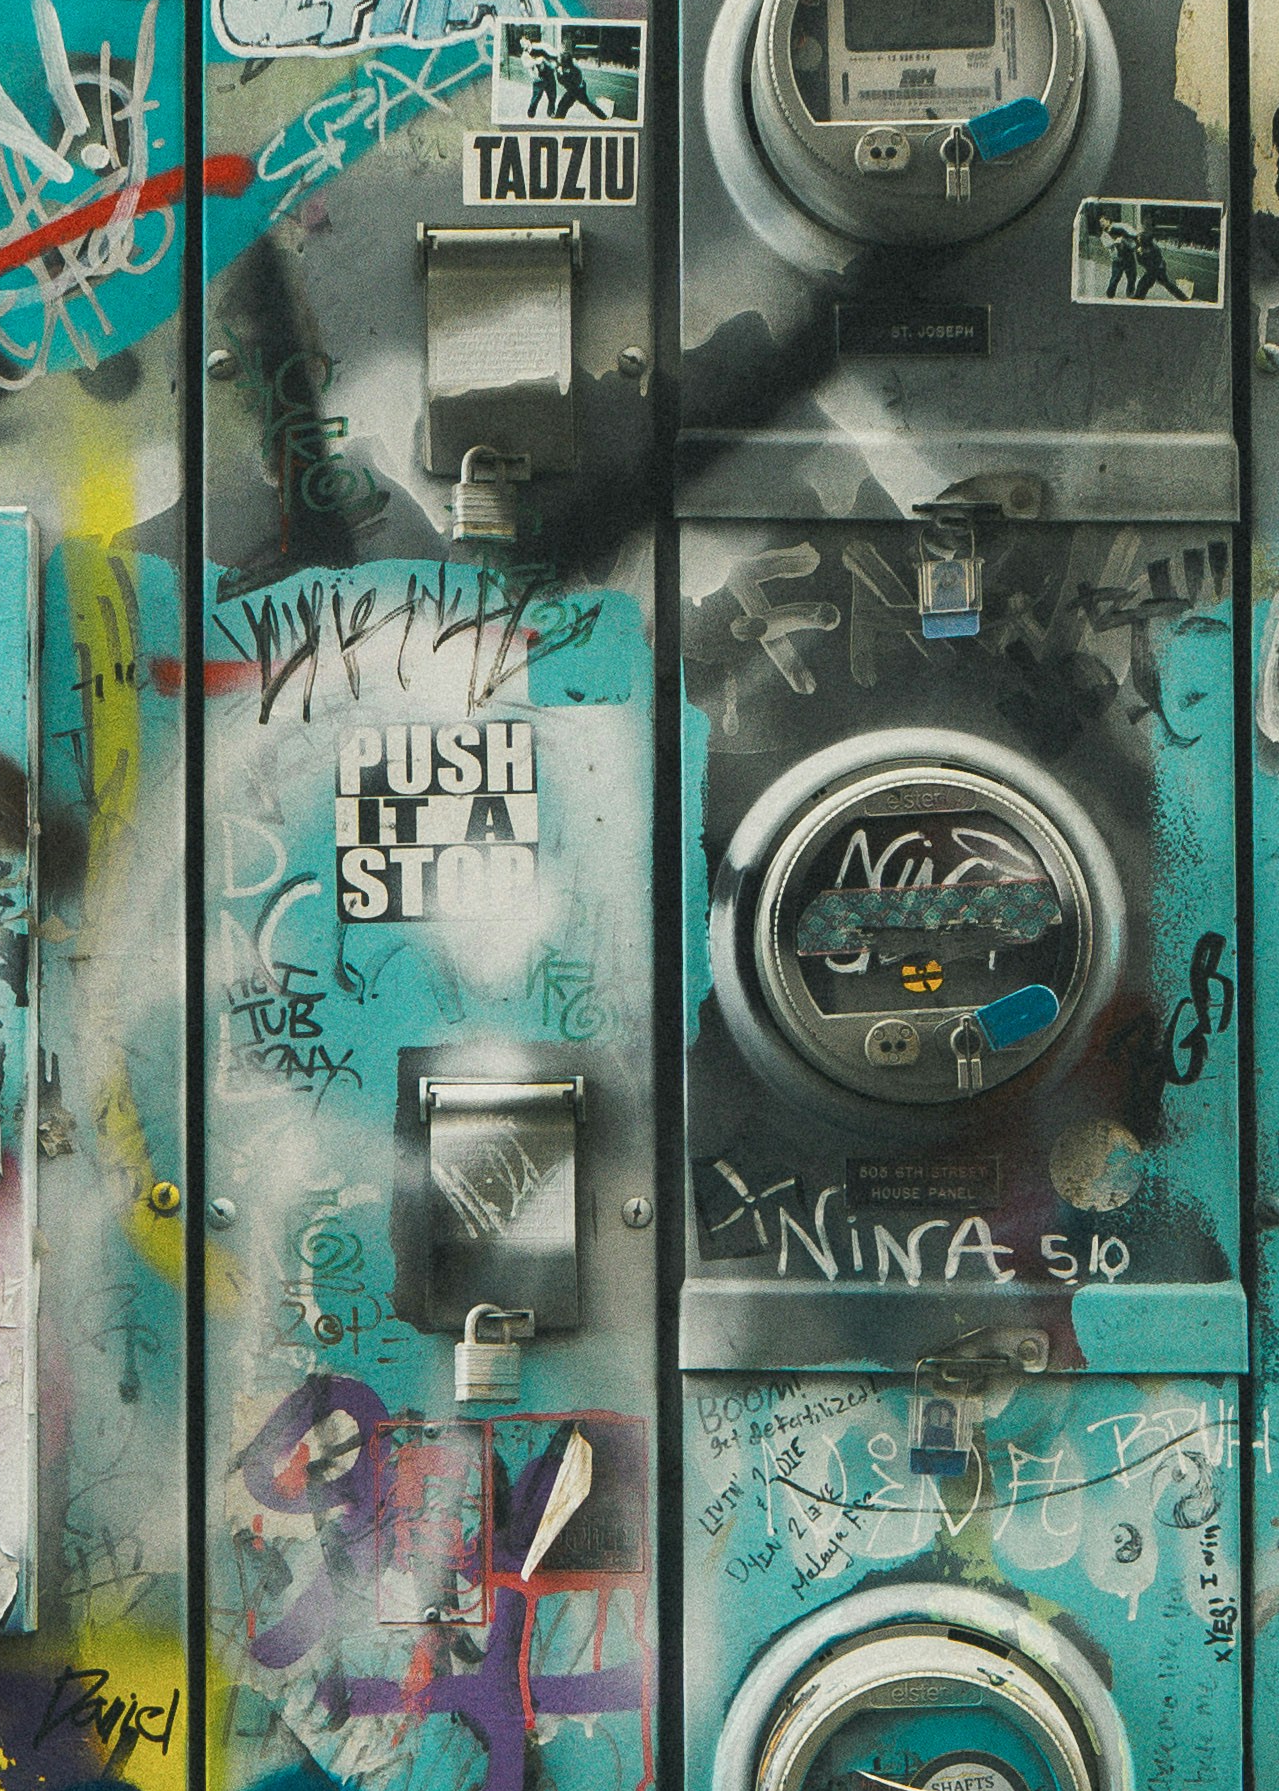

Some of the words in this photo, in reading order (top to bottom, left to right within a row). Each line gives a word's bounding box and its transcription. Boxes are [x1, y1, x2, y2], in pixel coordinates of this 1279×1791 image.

[473, 135, 636, 200] TADZIU
[918, 324, 975, 339] JOSEPH
[339, 723, 534, 796] PUSH
[356, 796, 429, 845] IT
[464, 796, 515, 843] A
[341, 845, 536, 920] STOP
[871, 1187, 921, 1200] HOUSE
[927, 1187, 978, 1200] PANEL
[931, 1165, 988, 1179] STREET
[775, 1435, 807, 1478] DIE
